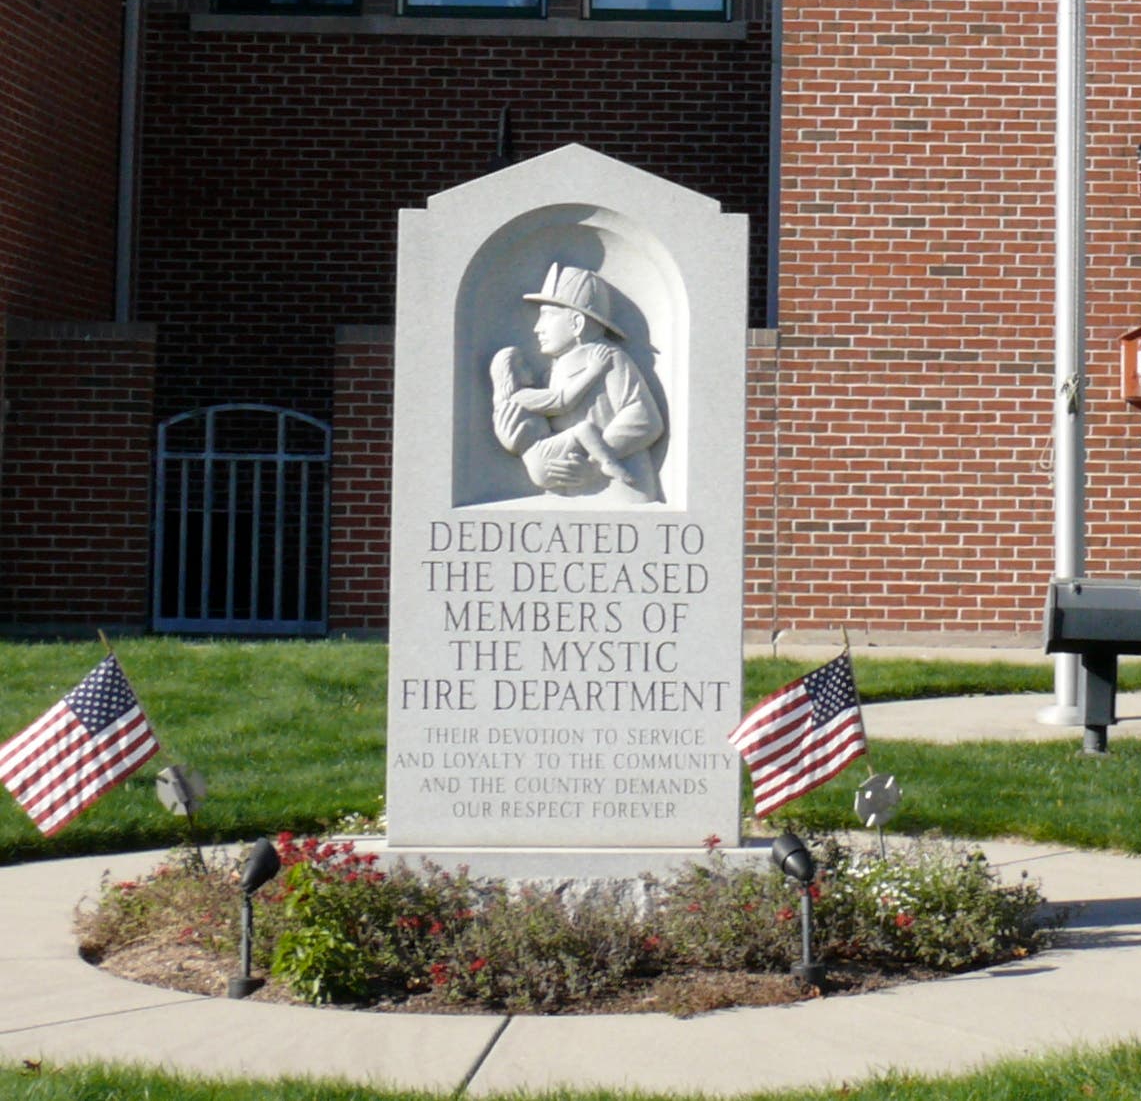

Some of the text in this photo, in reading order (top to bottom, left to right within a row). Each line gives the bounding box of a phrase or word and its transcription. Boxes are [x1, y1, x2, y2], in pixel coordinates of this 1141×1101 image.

[429, 521, 704, 555] DEDICATED TO
[421, 561, 709, 594] THE DECEASED
[444, 601, 689, 634] MEMBERS OF
[449, 640, 678, 673] THE MYSTIC
[401, 679, 730, 712] FIRE DEPARTMENT
[424, 727, 705, 746] THEIR DEVOTION TO SERVICE
[393, 752, 733, 770] AND LOYALTY TO THE COMMUNITY
[419, 777, 708, 795] AND THE COUNTRY DEMANDS
[452, 801, 677, 819] OUR RESPECT FOREVER
